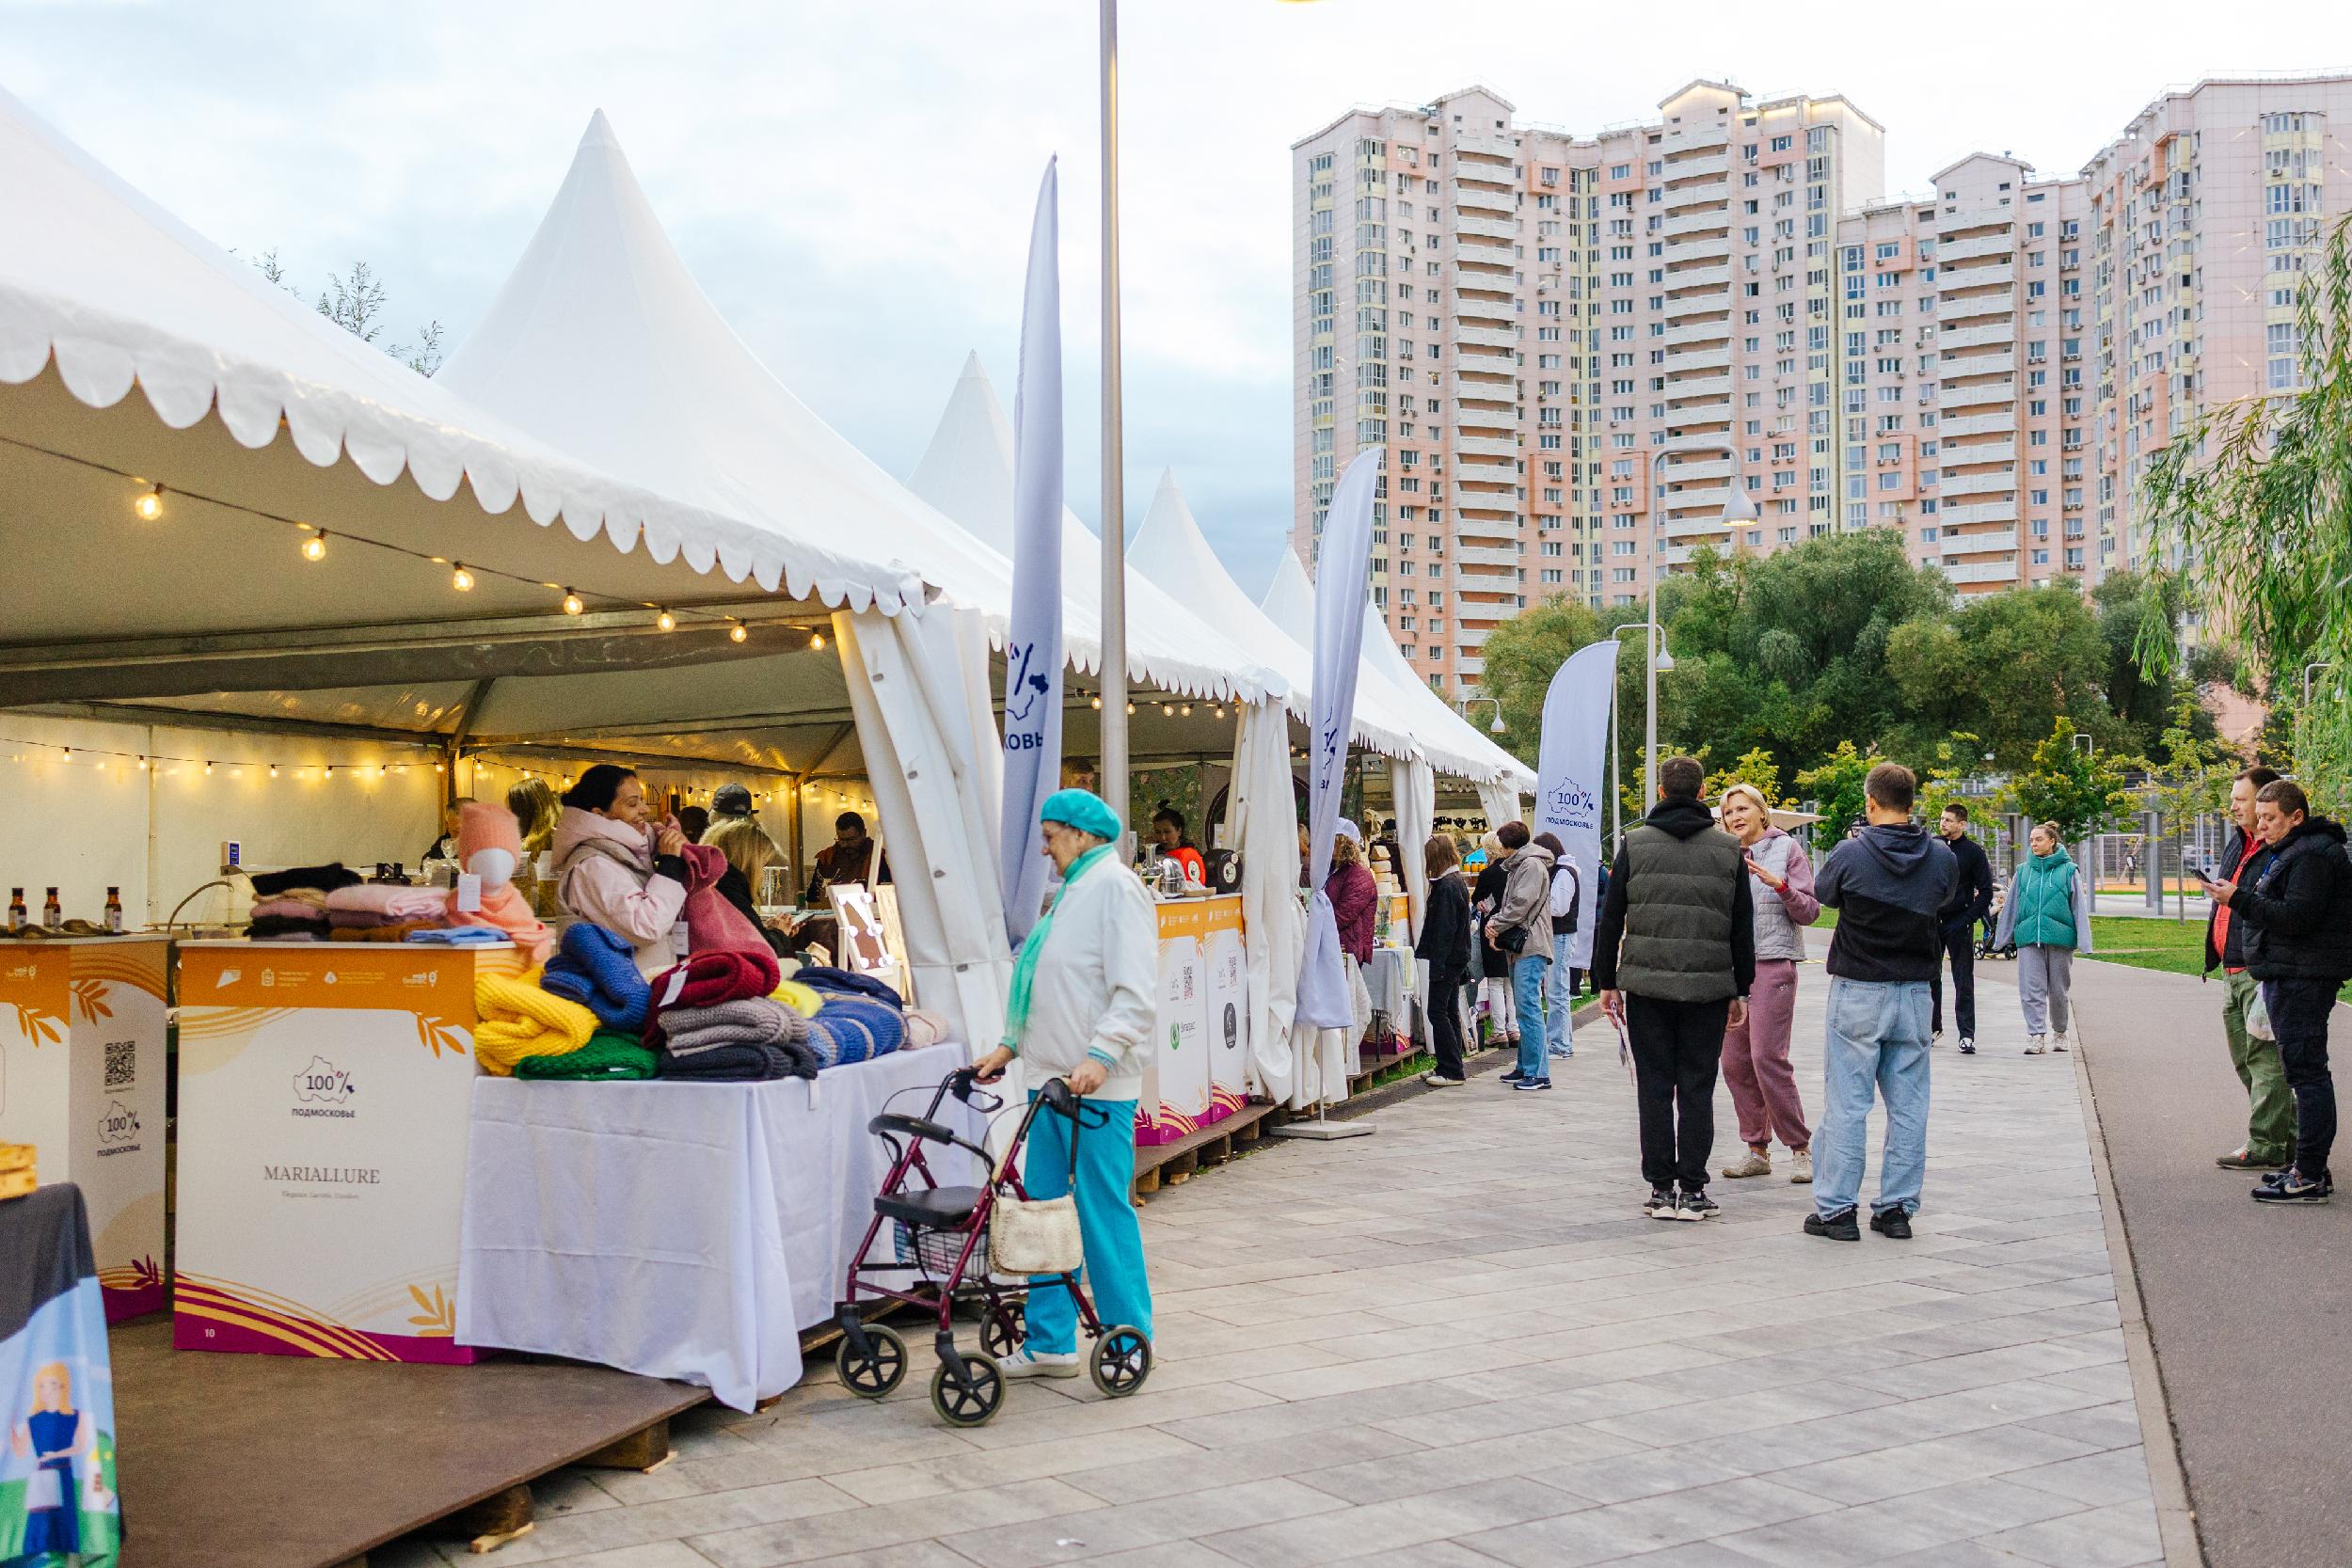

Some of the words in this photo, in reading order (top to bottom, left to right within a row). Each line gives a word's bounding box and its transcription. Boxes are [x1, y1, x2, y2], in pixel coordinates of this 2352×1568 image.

[1545, 816, 1594, 830] ПОДМОСКОВЬЕ
[292, 1108, 356, 1118] ПОДМОСКОВЬЕ
[97, 1144, 140, 1157] ПОДМОСКОВЬЕ
[263, 1165, 380, 1184] MARIALLURE
[204, 1328, 215, 1338] 10
